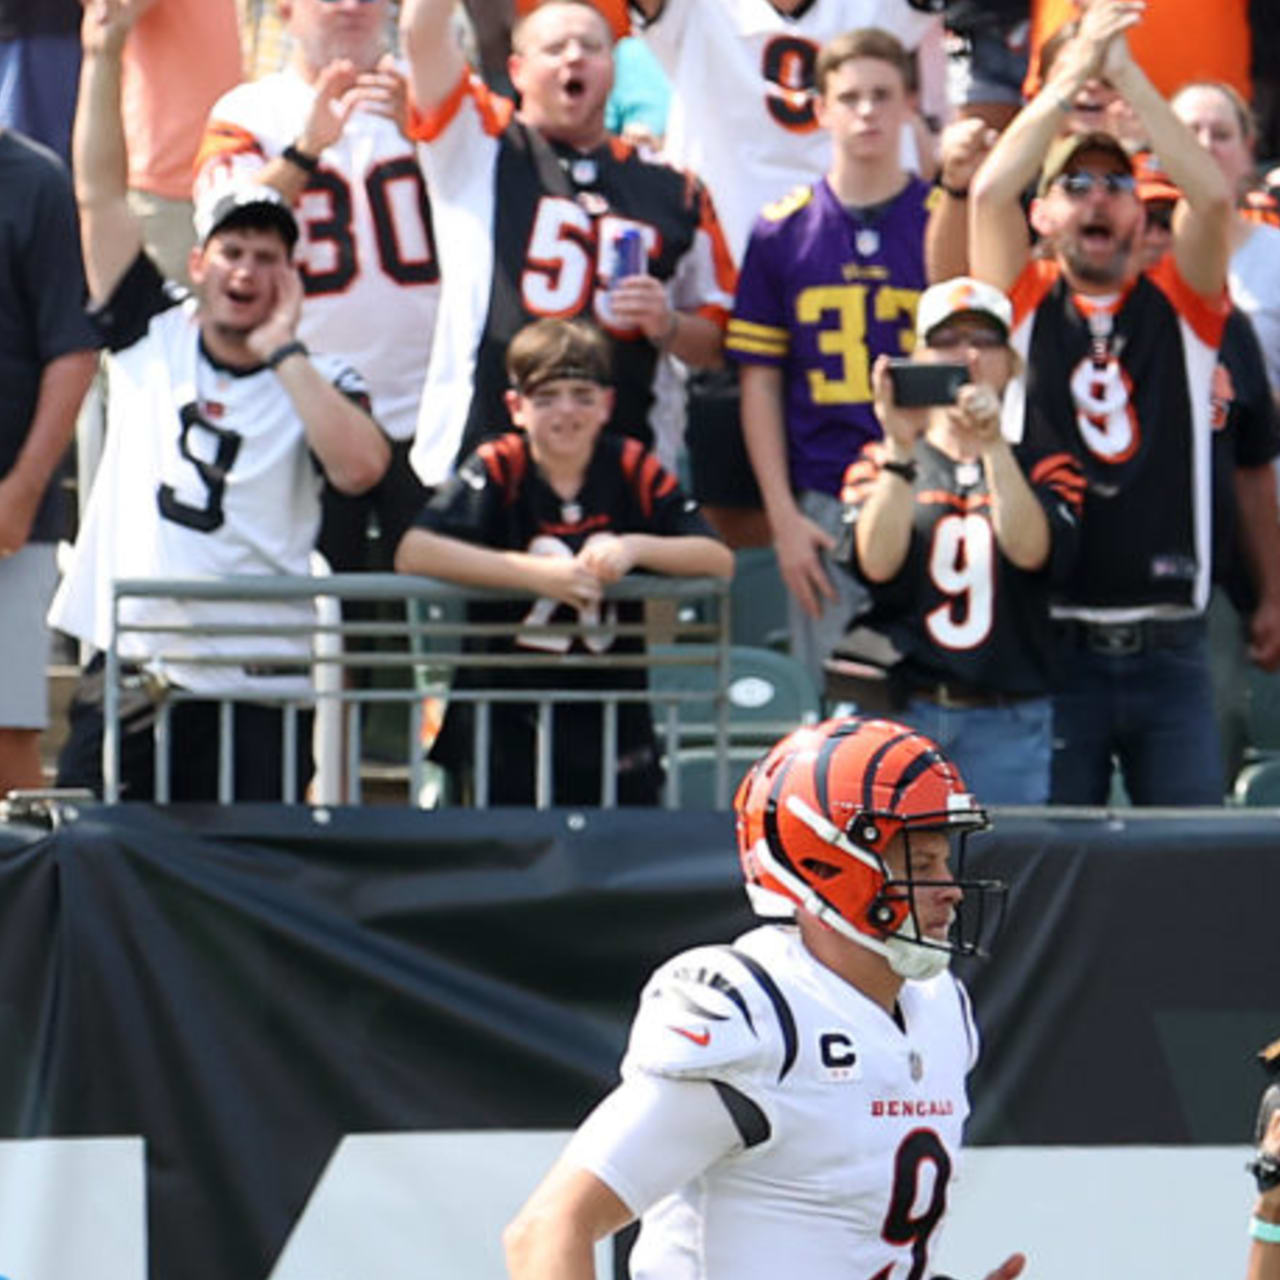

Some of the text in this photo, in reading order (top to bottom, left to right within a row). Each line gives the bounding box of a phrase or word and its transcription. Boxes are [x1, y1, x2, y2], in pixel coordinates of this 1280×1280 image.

[297, 157, 443, 299] 30
[157, 402, 245, 535] 9
[1069, 357, 1142, 463] 9
[926, 512, 995, 652] 9
[820, 1033, 856, 1068] C
[871, 1100, 954, 1118] BENGALS
